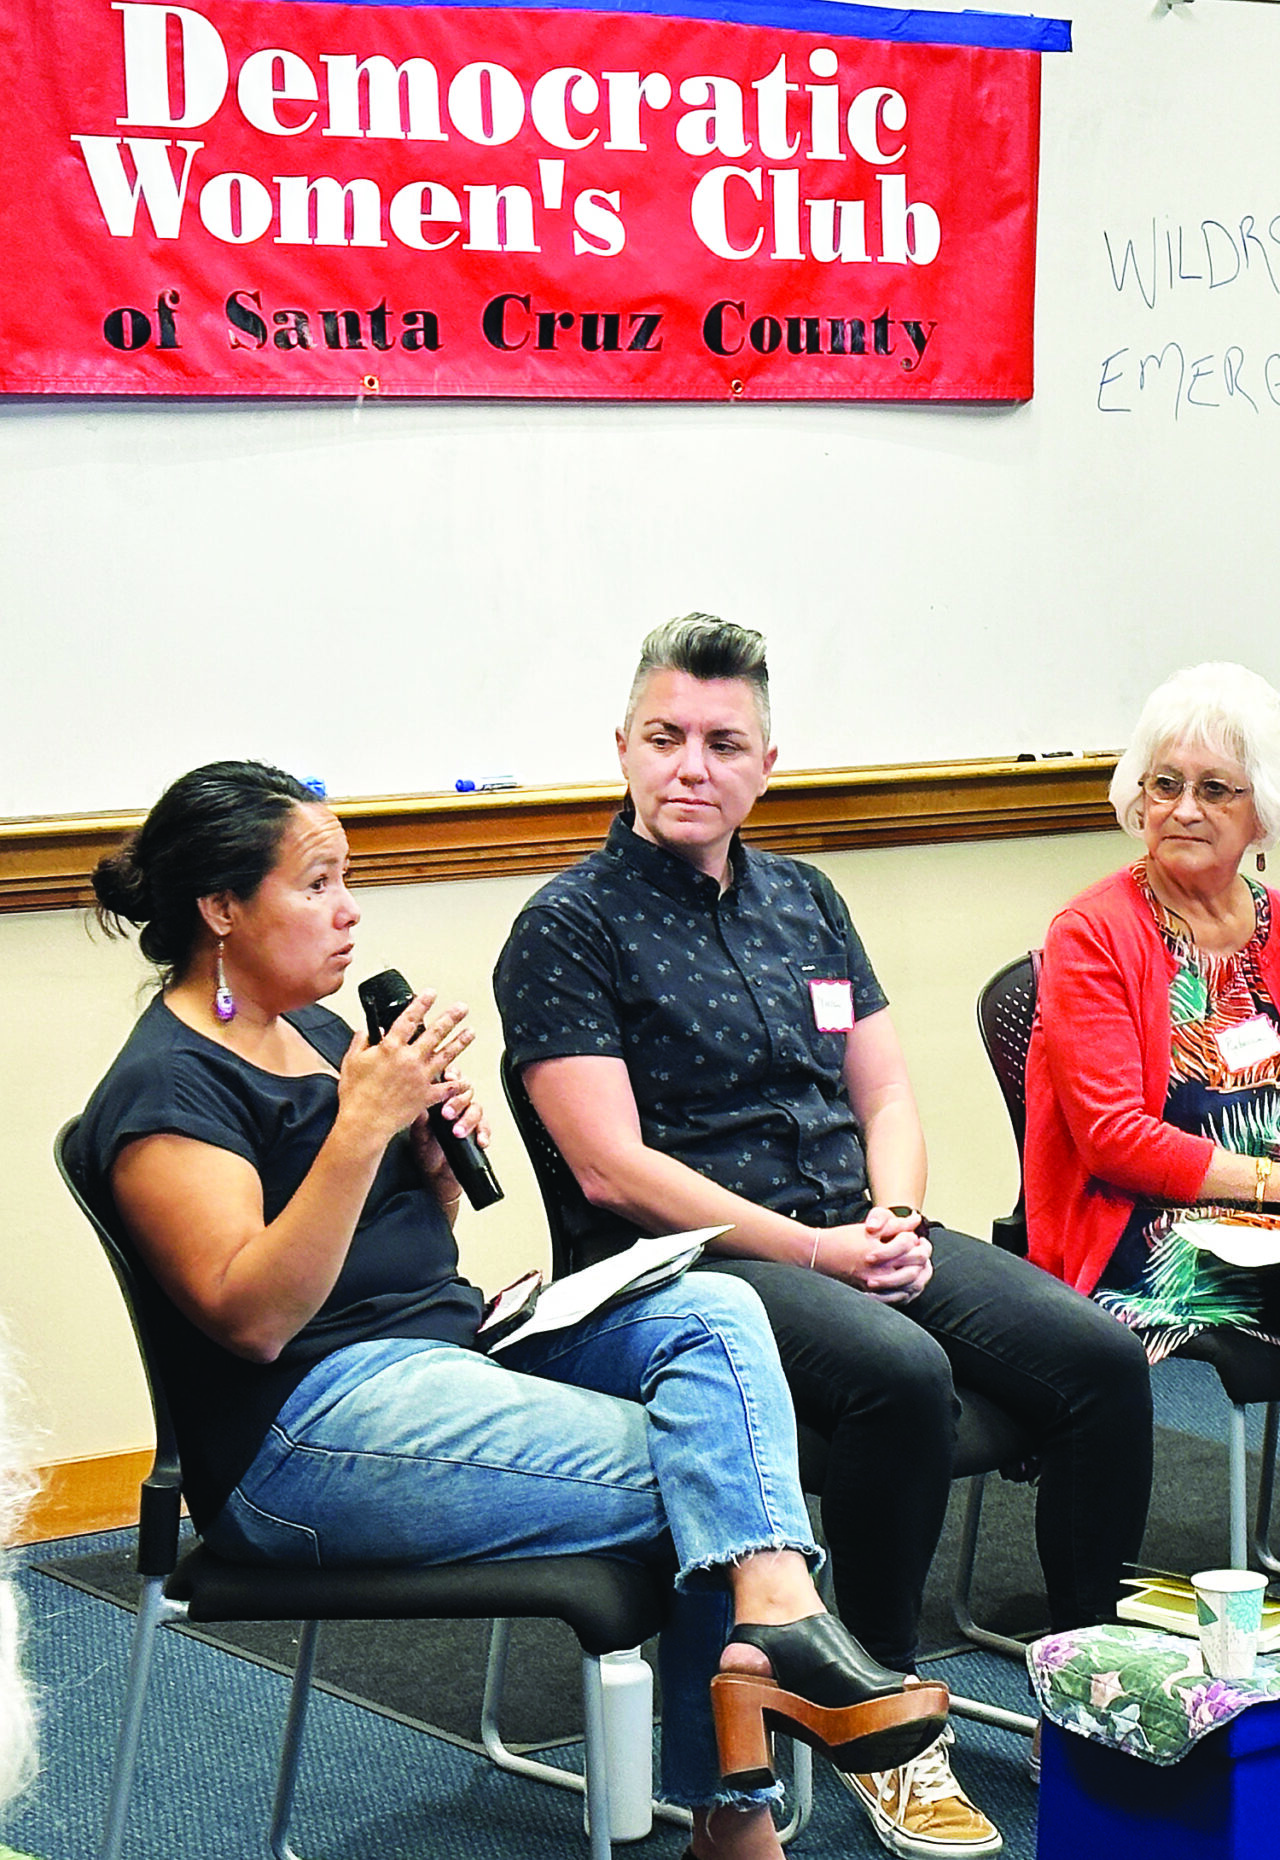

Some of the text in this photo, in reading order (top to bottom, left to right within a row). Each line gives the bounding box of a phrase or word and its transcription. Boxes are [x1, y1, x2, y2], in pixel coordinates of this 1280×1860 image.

[111, 2, 908, 165] Democratic
[70, 133, 942, 267] Women's Club
[102, 289, 938, 371] of Santa Cruz County
